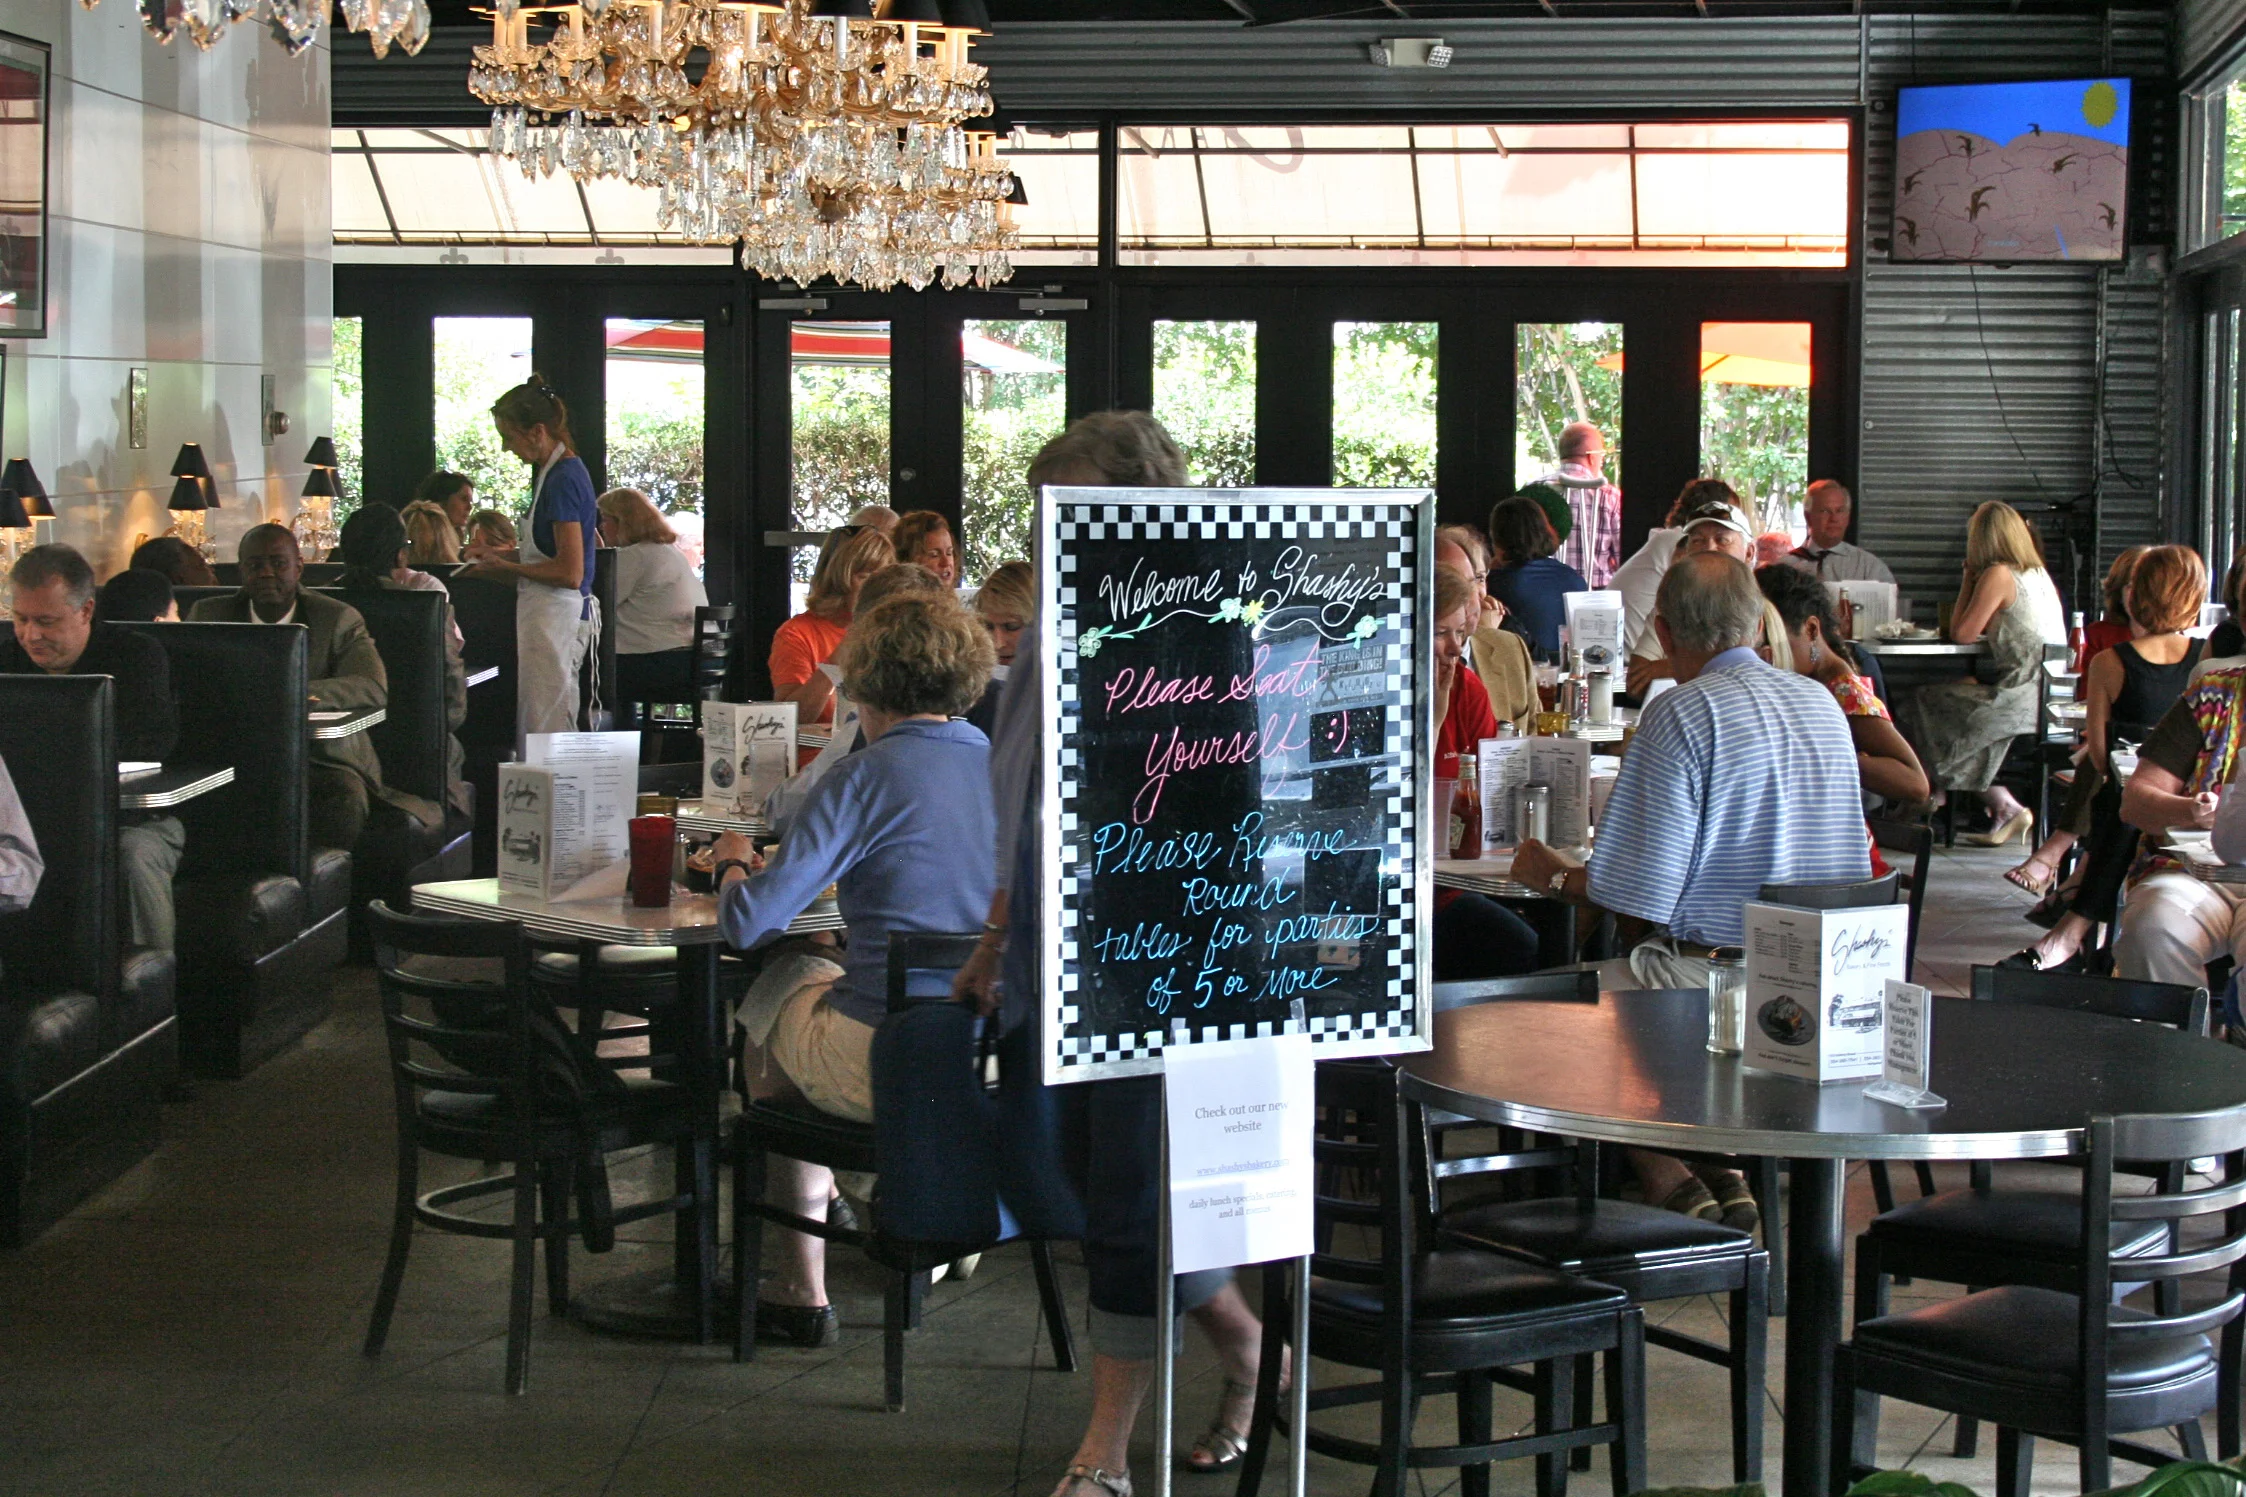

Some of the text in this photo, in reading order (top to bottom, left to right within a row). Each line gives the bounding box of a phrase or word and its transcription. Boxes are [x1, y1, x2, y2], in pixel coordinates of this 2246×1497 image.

[1099, 556, 1223, 621] Welcome
[1237, 560, 1258, 595] to
[1263, 545, 1389, 627] Shashy's
[1105, 643, 1329, 715] Please Seat
[1132, 712, 1310, 824] Yourself
[1093, 811, 1358, 875] Please Reserve
[1183, 867, 1297, 917] Round
[1094, 901, 1380, 970] tables for parties
[1146, 967, 1181, 1015] of
[1193, 967, 1223, 1009] 5
[1223, 968, 1248, 996] or
[1194, 1101, 1287, 1120] Check out our new
[1223, 1120, 1263, 1134] website
[1188, 1197, 1208, 1210] daily
[1209, 1194, 1231, 1208] lunch
[1218, 1208, 1233, 1219] and
[1234, 1207, 1244, 1217] all
